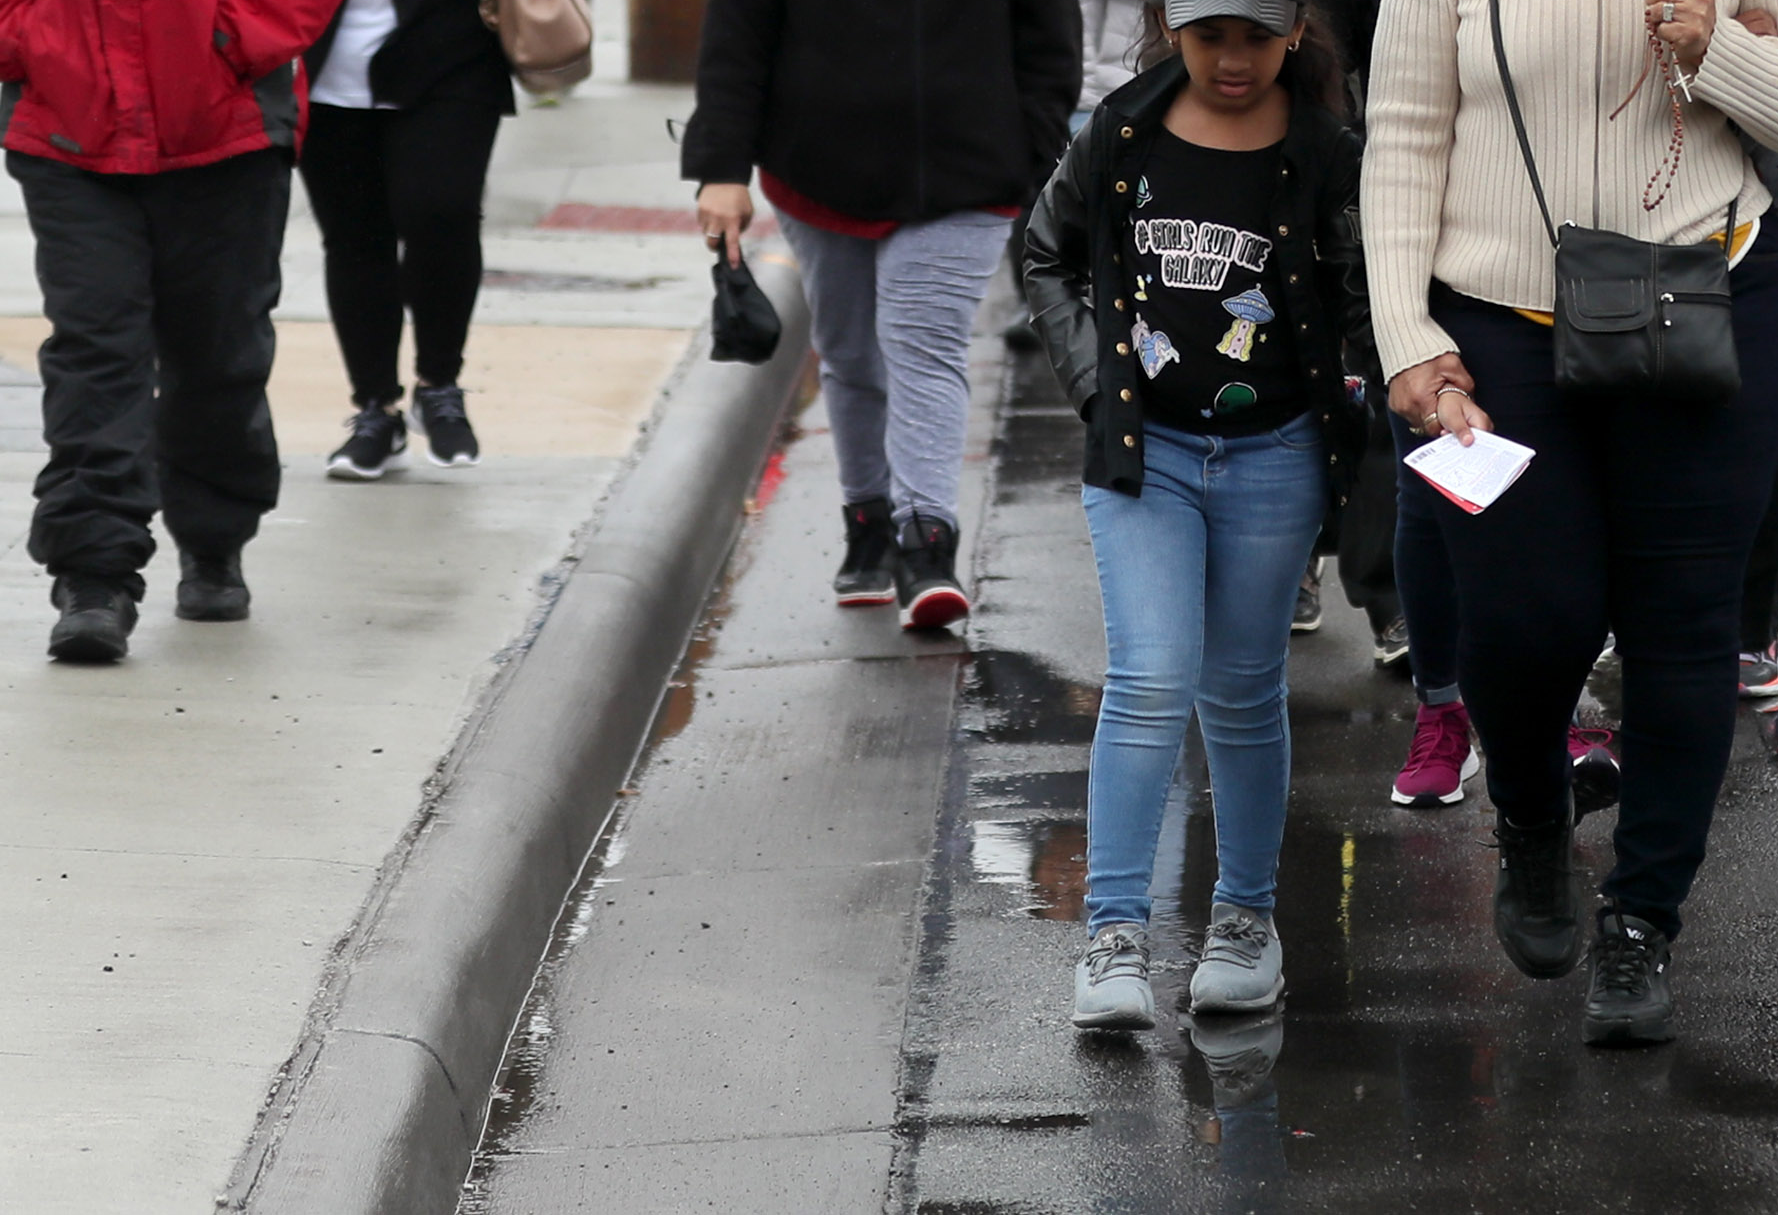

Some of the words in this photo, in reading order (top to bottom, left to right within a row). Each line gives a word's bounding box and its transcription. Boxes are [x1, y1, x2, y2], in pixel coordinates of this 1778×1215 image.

[1201, 224, 1237, 259] RUN
[1237, 233, 1270, 269] THE
[1163, 254, 1226, 287] GALAXY
